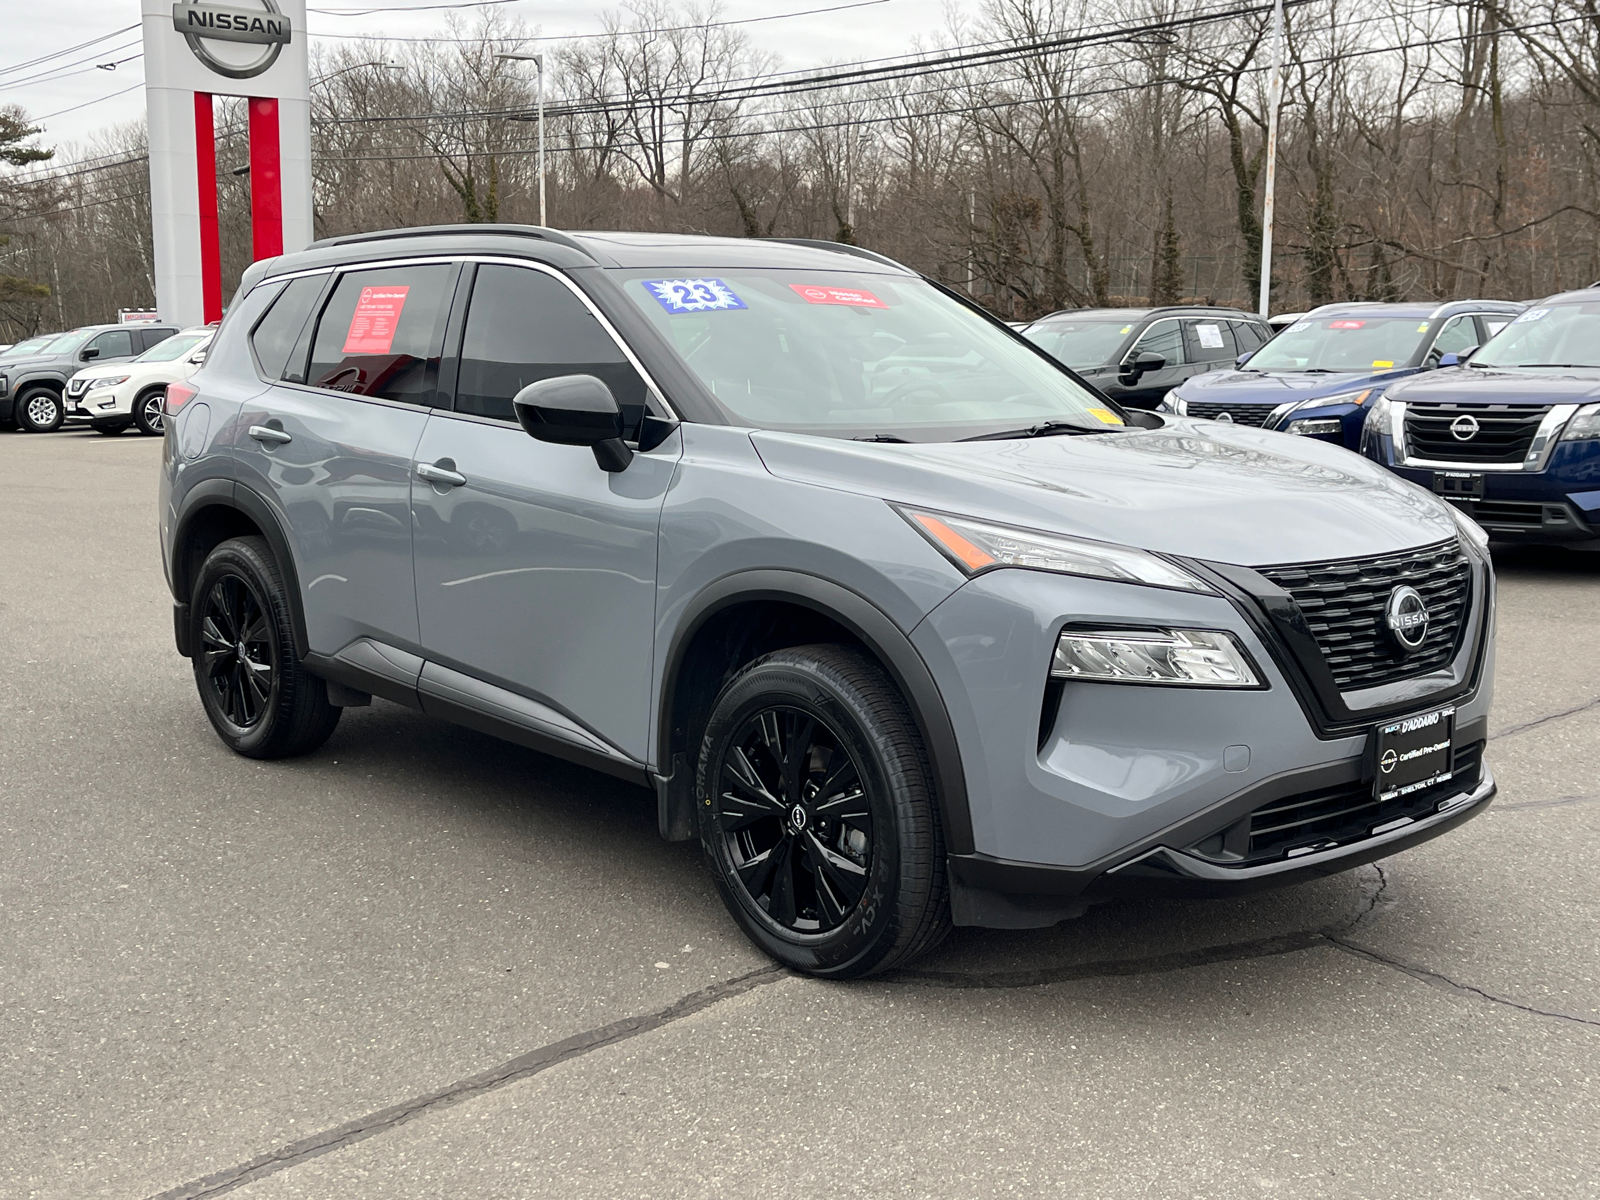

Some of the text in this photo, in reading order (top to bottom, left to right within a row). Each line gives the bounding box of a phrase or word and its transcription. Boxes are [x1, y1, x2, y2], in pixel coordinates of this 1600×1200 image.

[188, 10, 282, 36] NISSAN
[673, 284, 718, 304] 23
[835, 295, 877, 304] Certified
[1390, 612, 1430, 627] NISSAN
[1385, 725, 1400, 734] BUICK
[1401, 713, 1439, 733] D'ADDARIO
[1400, 739, 1450, 761] Certified Pre-Owned
